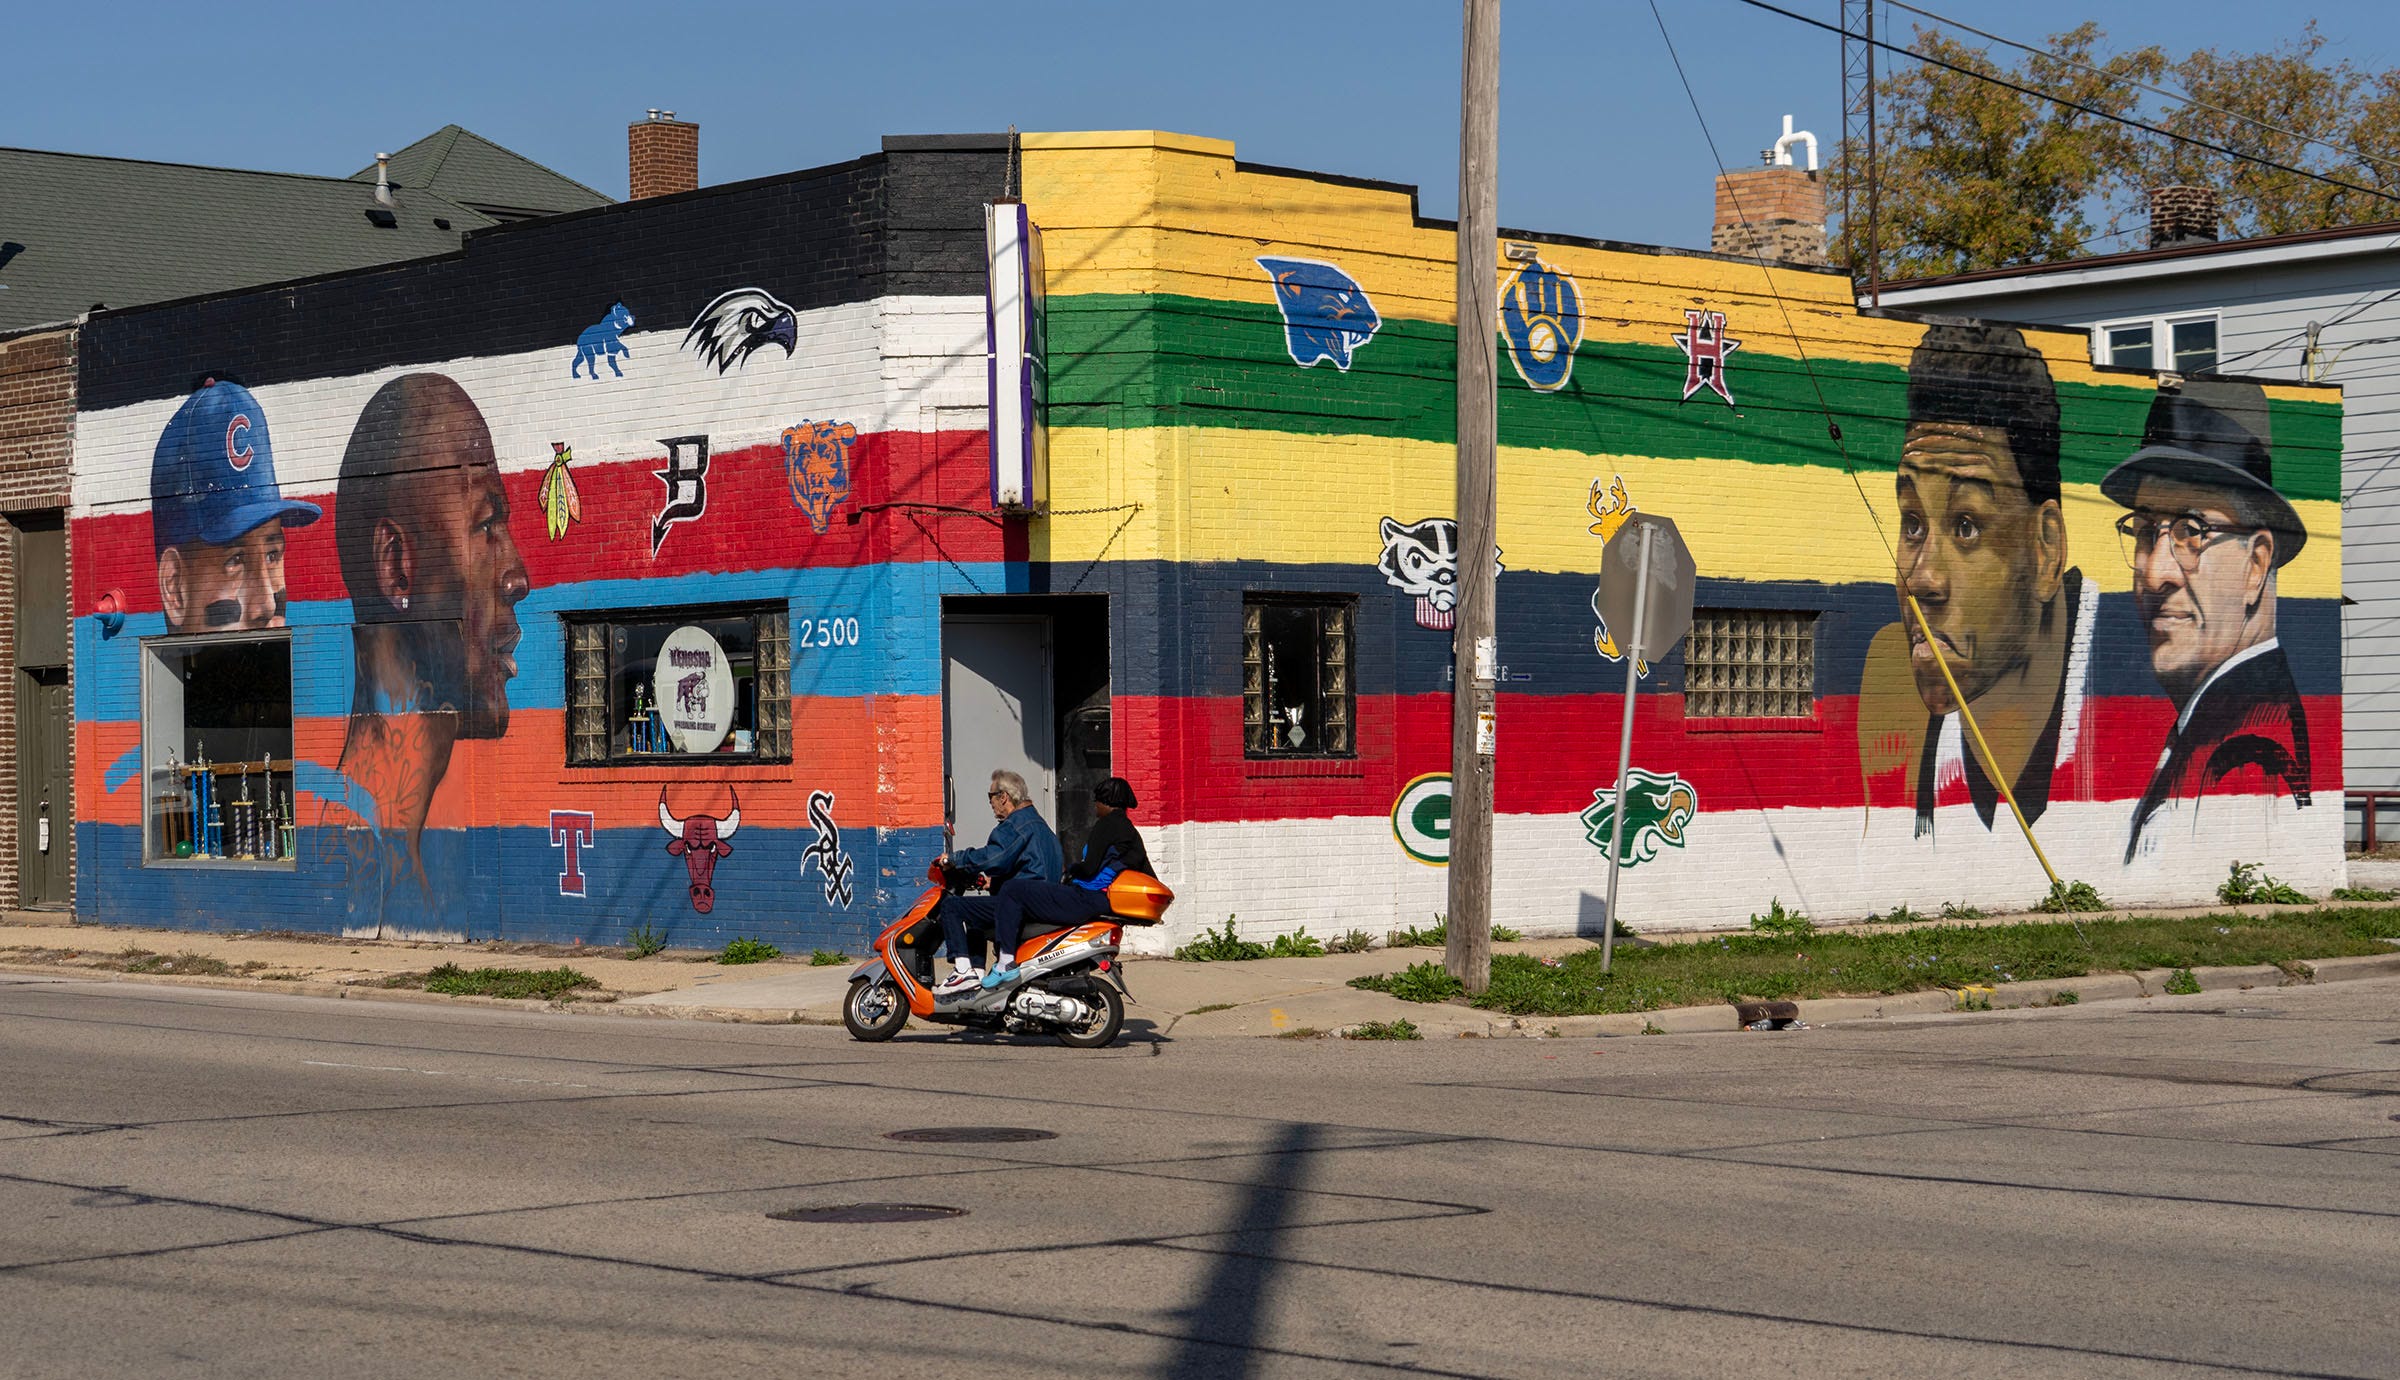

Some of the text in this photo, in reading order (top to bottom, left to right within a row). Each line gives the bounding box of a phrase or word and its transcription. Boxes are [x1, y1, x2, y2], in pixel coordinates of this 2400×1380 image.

[1680, 309, 1737, 409] H
[226, 413, 254, 471] C
[652, 434, 710, 560] B
[669, 648, 711, 668] KENOSHA
[801, 617, 859, 648] 2500
[550, 810, 594, 898] T
[1037, 949, 1065, 963] MALIBU
